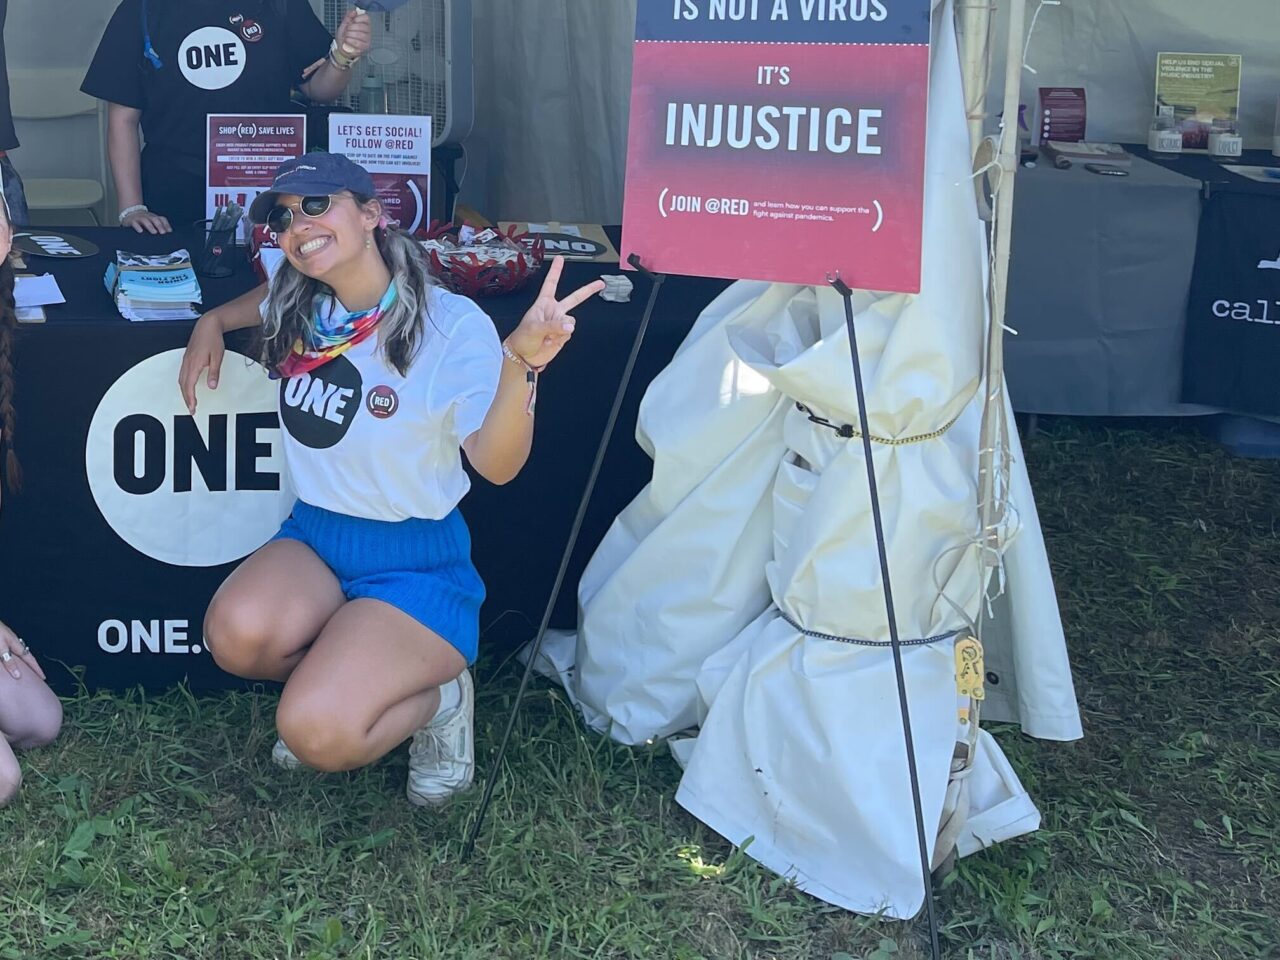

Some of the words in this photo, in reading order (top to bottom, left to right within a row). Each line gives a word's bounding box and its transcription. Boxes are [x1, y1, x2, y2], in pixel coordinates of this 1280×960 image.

[186, 42, 238, 70] ONE
[757, 65, 790, 85] IT'S
[219, 126, 237, 135] SHOP
[258, 126, 275, 135] SAVE
[276, 126, 295, 135] LIVES
[337, 125, 362, 136] LET'S
[365, 126, 382, 137] GET
[385, 126, 422, 138] SOCIAL!
[665, 102, 883, 155] INJUSTICE
[346, 138, 382, 149] FOLLOW
[385, 140, 414, 150] @RED
[705, 198, 749, 216] @RED
[829, 206, 856, 215] support
[753, 210, 769, 219] fight
[769, 211, 794, 220] against
[795, 213, 835, 222] pandemics.
[29, 235, 82, 255] ONE
[284, 372, 354, 425] ONE
[113, 411, 281, 495] ONE
[97, 618, 211, 654] ONE.
